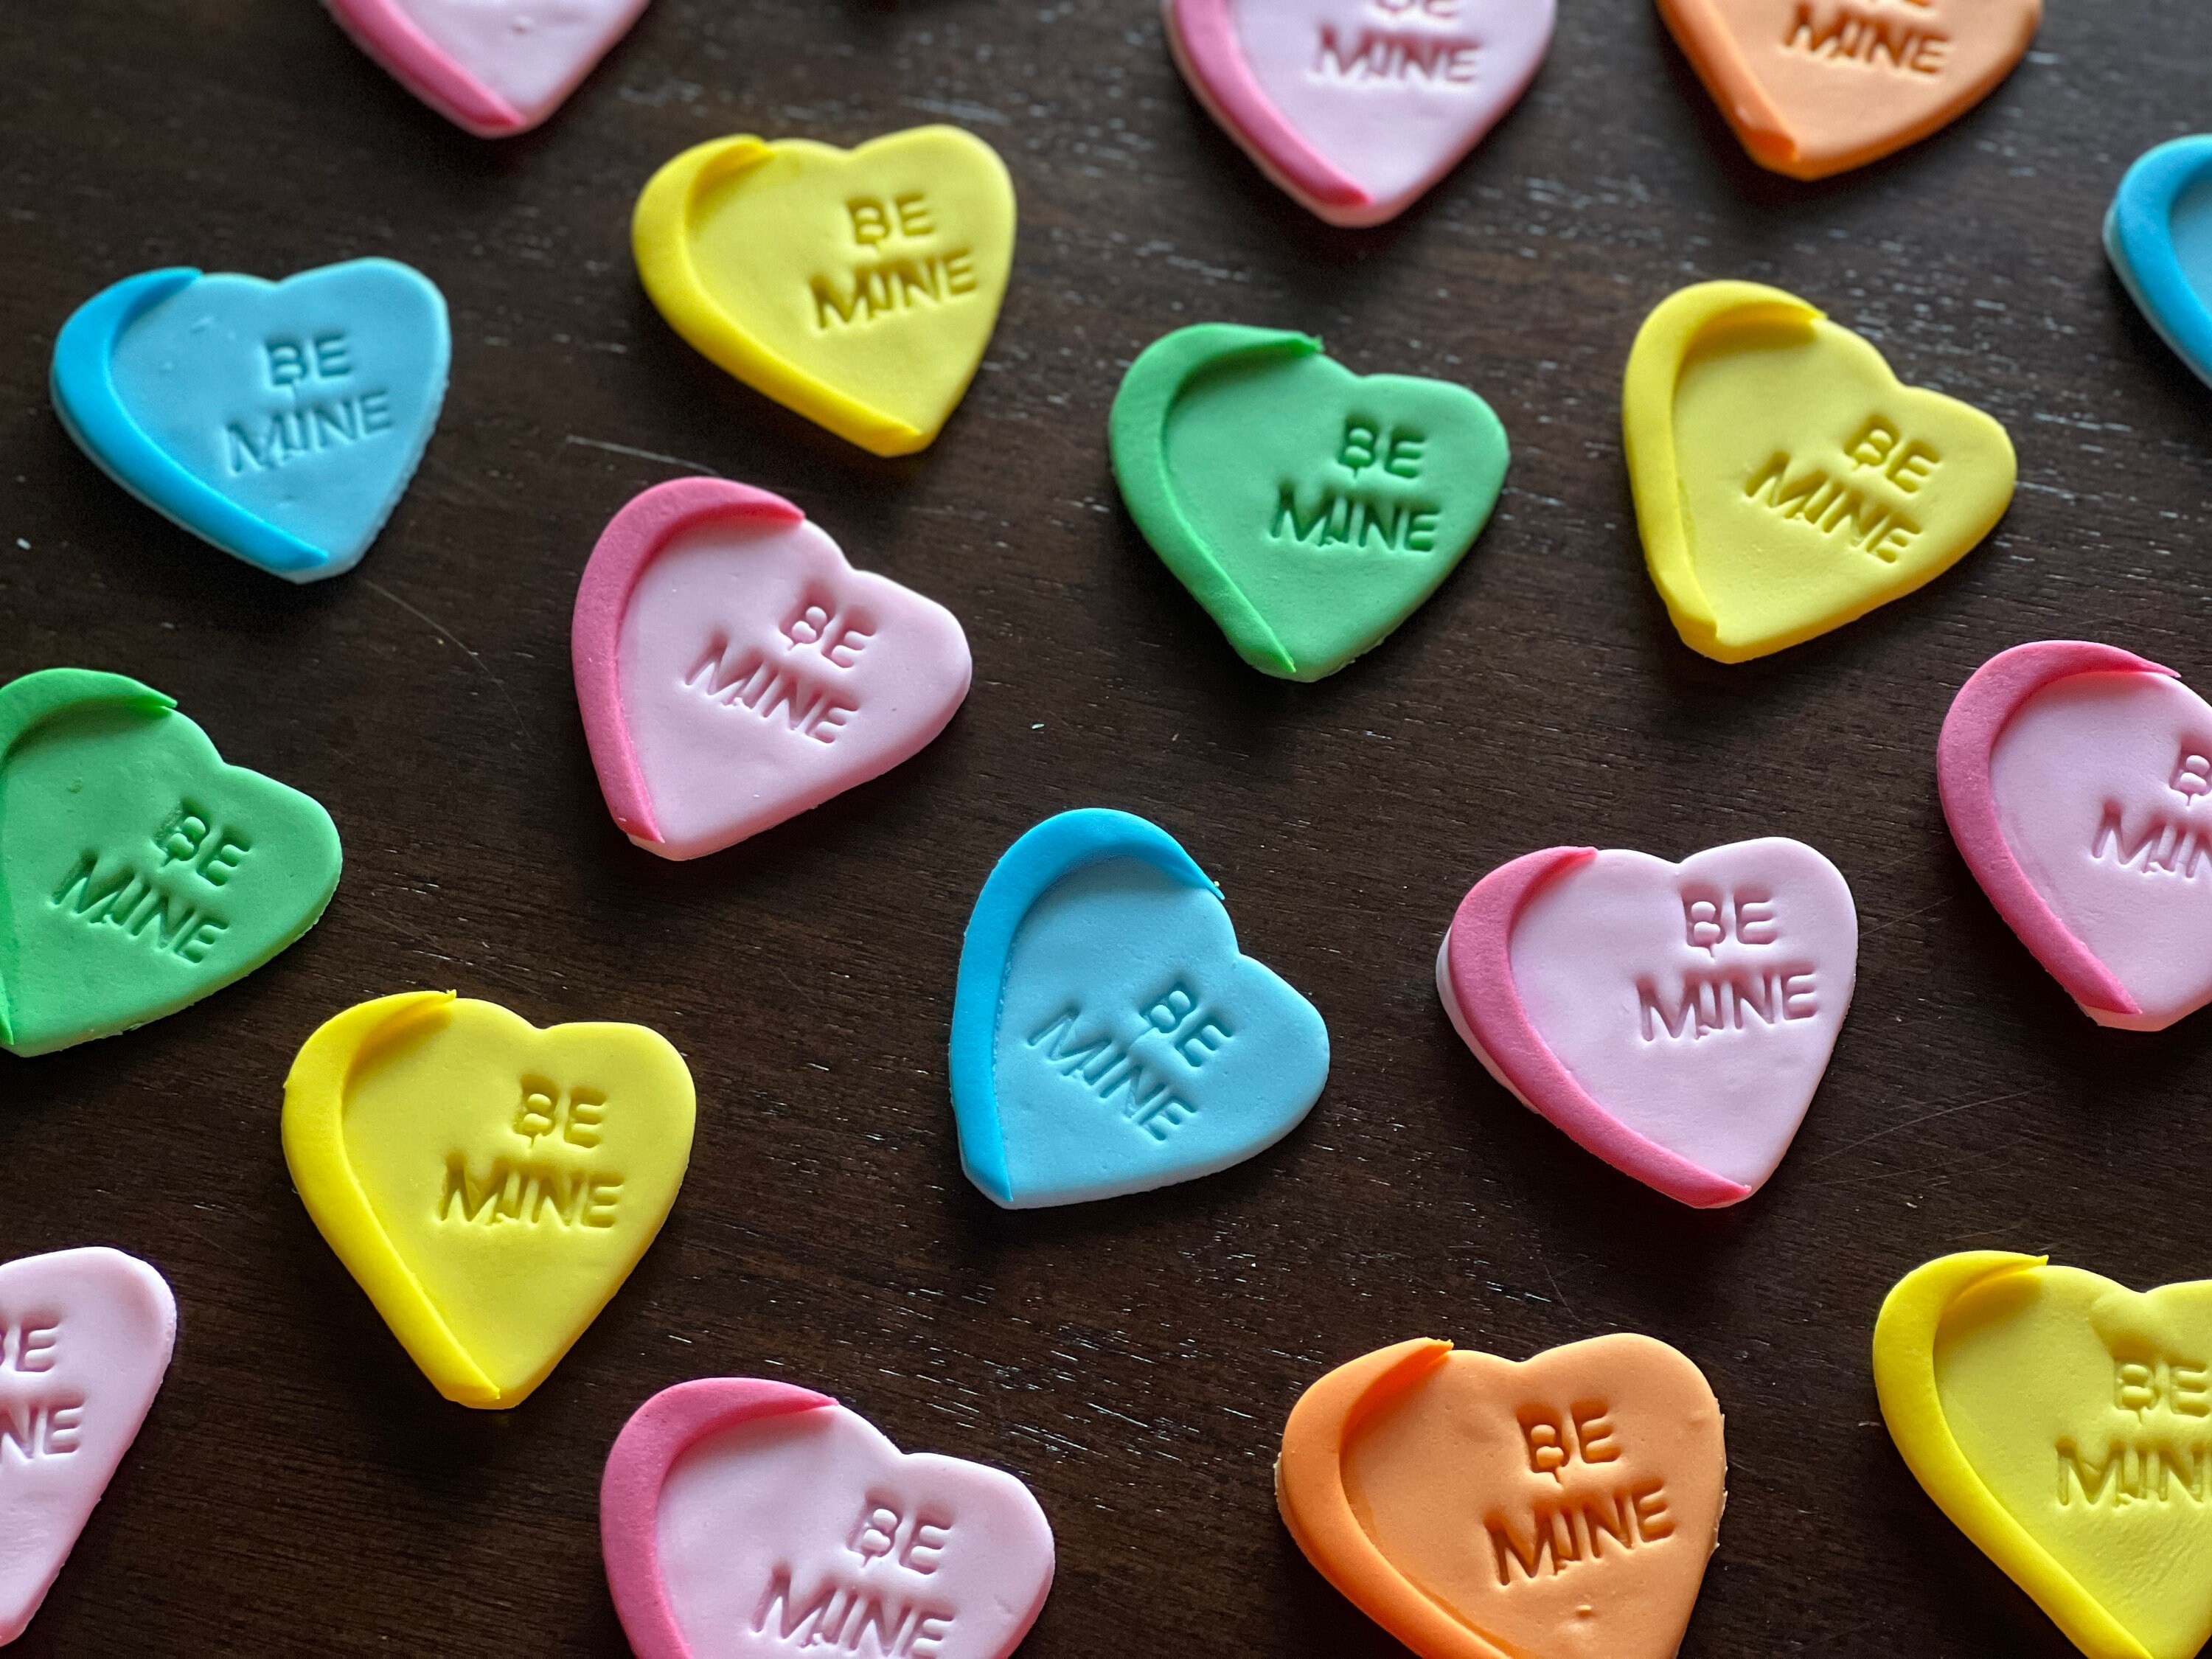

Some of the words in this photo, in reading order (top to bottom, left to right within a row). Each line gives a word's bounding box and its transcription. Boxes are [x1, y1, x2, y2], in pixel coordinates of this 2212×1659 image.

[1315, 24, 1482, 84] MINE
[1781, 1, 1950, 74] MINE
[844, 192, 935, 248] BE
[810, 248, 978, 330] MINE
[264, 331, 354, 391] BE
[223, 391, 394, 476] MINE
[1336, 413, 1427, 479] BE
[1843, 413, 1941, 493] BE
[1270, 481, 1441, 552] MINE
[1744, 448, 1922, 564] MINE
[779, 582, 877, 669] BE
[684, 628, 860, 744] MINE
[2169, 734, 2212, 807] B
[151, 796, 253, 887] BE
[2091, 798, 2212, 878] MIN
[50, 848, 230, 964] MINE
[1680, 883, 1778, 959] BE
[1139, 977, 1234, 1068] BE
[1633, 961, 1818, 1042] MINE
[1025, 997, 1197, 1141] MINE
[512, 1073, 607, 1149] BE
[438, 1150, 625, 1228] MINE
[0, 1309, 62, 1372] E
[2110, 1340, 2211, 1425] BE
[0, 1391, 87, 1459] NE
[1515, 1403, 1622, 1482] BE
[2054, 1438, 2212, 1506] MIN
[846, 1488, 954, 1575] BE
[1482, 1477, 1675, 1586] MINE
[751, 1559, 956, 1659] MINE
